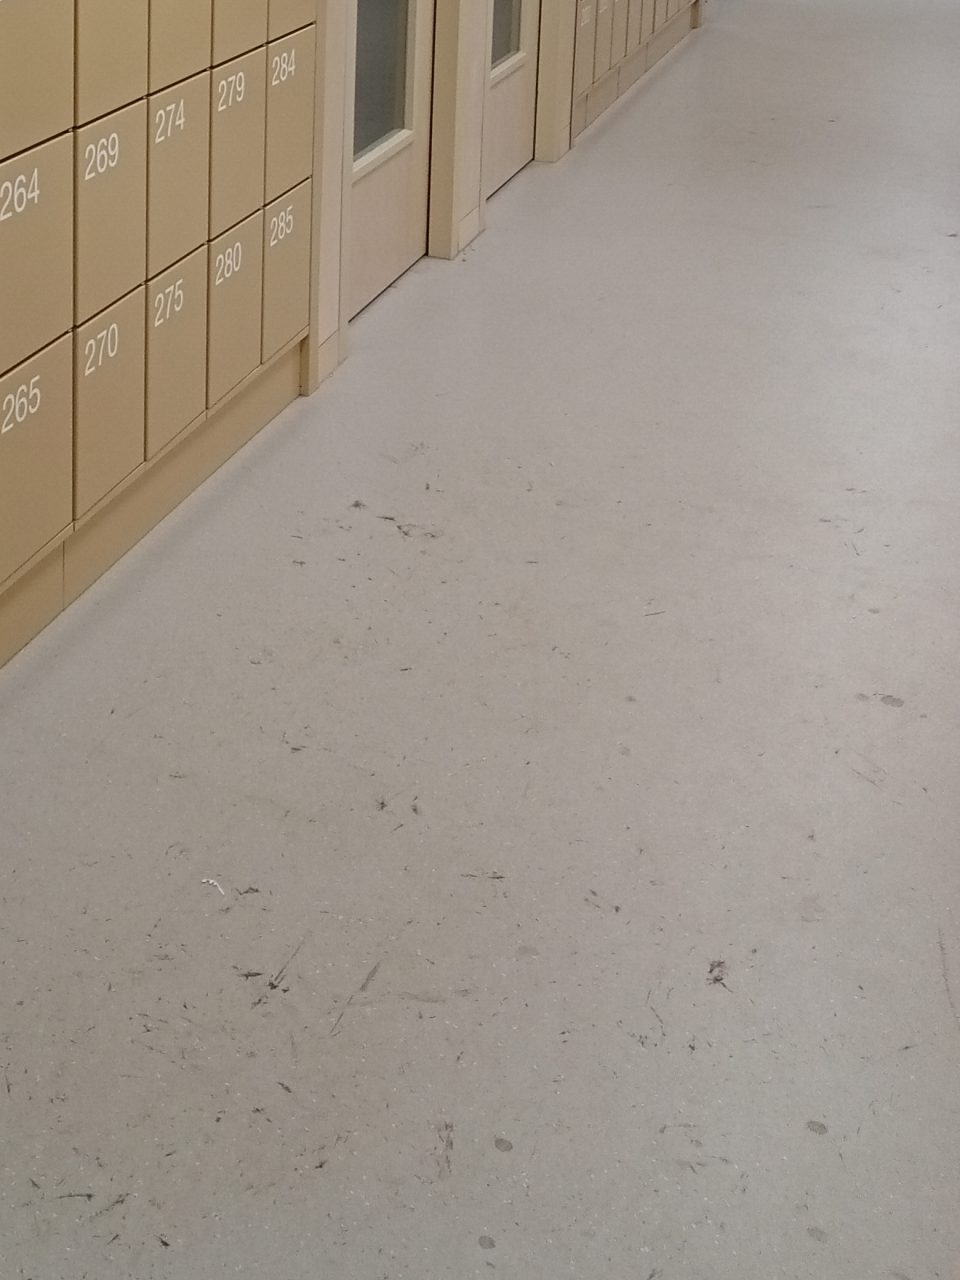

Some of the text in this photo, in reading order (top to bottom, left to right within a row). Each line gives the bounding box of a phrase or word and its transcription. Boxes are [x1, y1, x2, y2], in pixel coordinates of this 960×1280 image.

[271, 49, 296, 86] 284
[217, 71, 245, 112] 279
[155, 99, 185, 144] 274
[84, 132, 119, 181] 269
[0, 167, 40, 222] 264
[270, 205, 293, 247] 285
[215, 242, 242, 286] 280
[154, 278, 184, 327] 275
[84, 323, 119, 376] 270
[1, 375, 41, 434] 265
